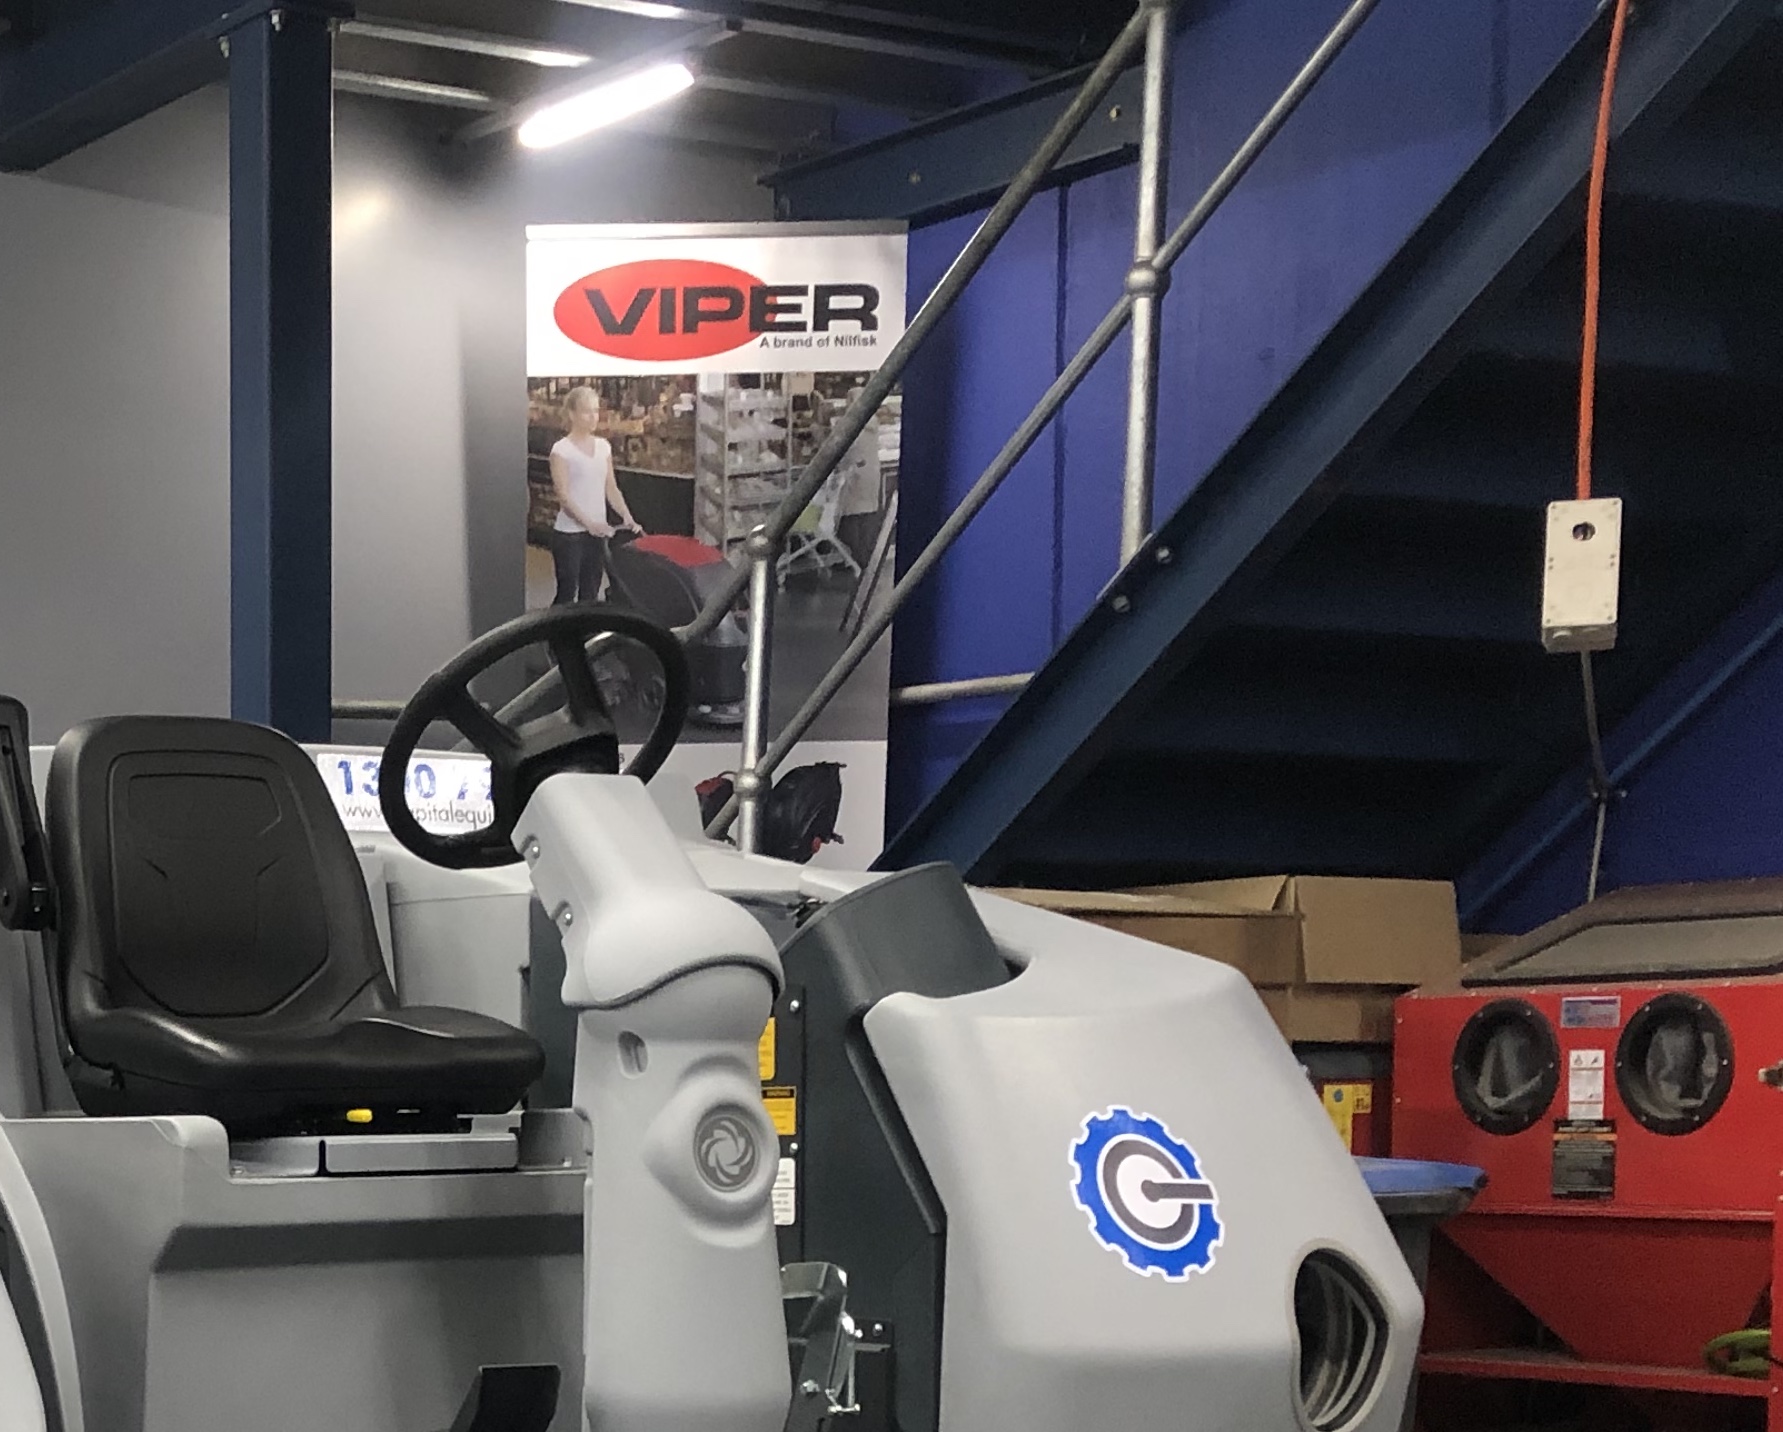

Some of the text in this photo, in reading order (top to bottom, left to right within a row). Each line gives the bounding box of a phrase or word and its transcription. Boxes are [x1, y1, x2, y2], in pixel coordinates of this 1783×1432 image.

[583, 283, 881, 336] VIPER
[759, 333, 878, 349] A brand of Nilfisk
[337, 759, 437, 799] 130
